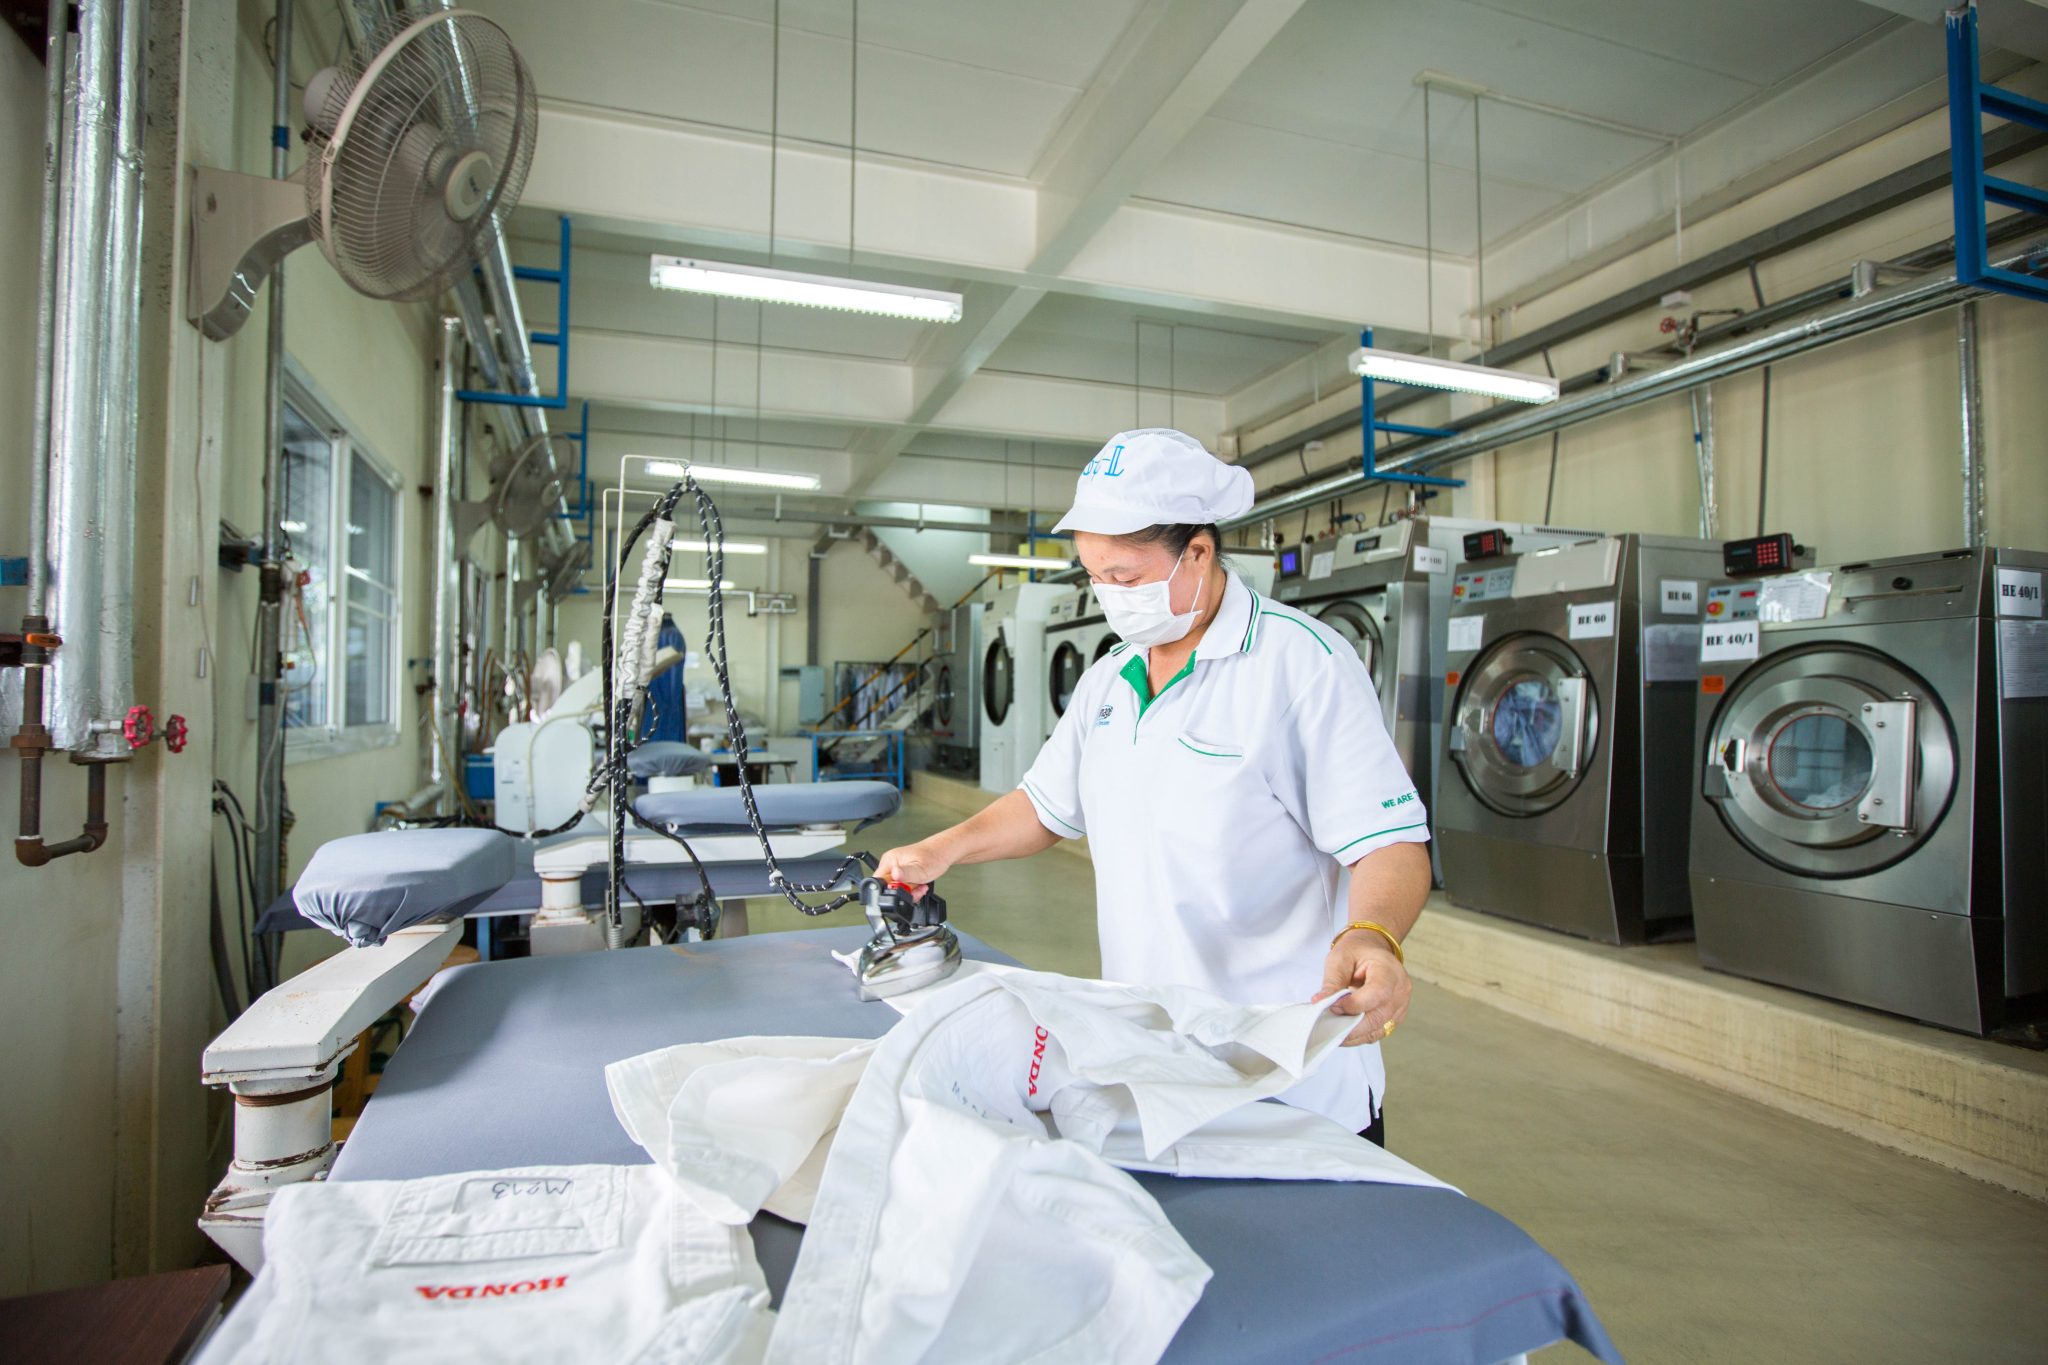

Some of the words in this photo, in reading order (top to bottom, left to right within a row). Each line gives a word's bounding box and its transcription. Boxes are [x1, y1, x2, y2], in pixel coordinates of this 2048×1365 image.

[1667, 590, 1680, 601] HE
[1681, 591, 1692, 601] 60
[2001, 584, 2017, 598] HE
[2018, 585, 2039, 601] 40/1
[1578, 615, 1592, 625] HE
[1594, 614, 1606, 623] 60
[1706, 634, 1724, 647] HE
[1727, 632, 1754, 646] 40/1
[1381, 798, 1397, 809] WE
[1397, 792, 1414, 805] ARE
[1028, 1025, 1049, 1098] ONDA
[416, 1274, 569, 1301] HONDA
